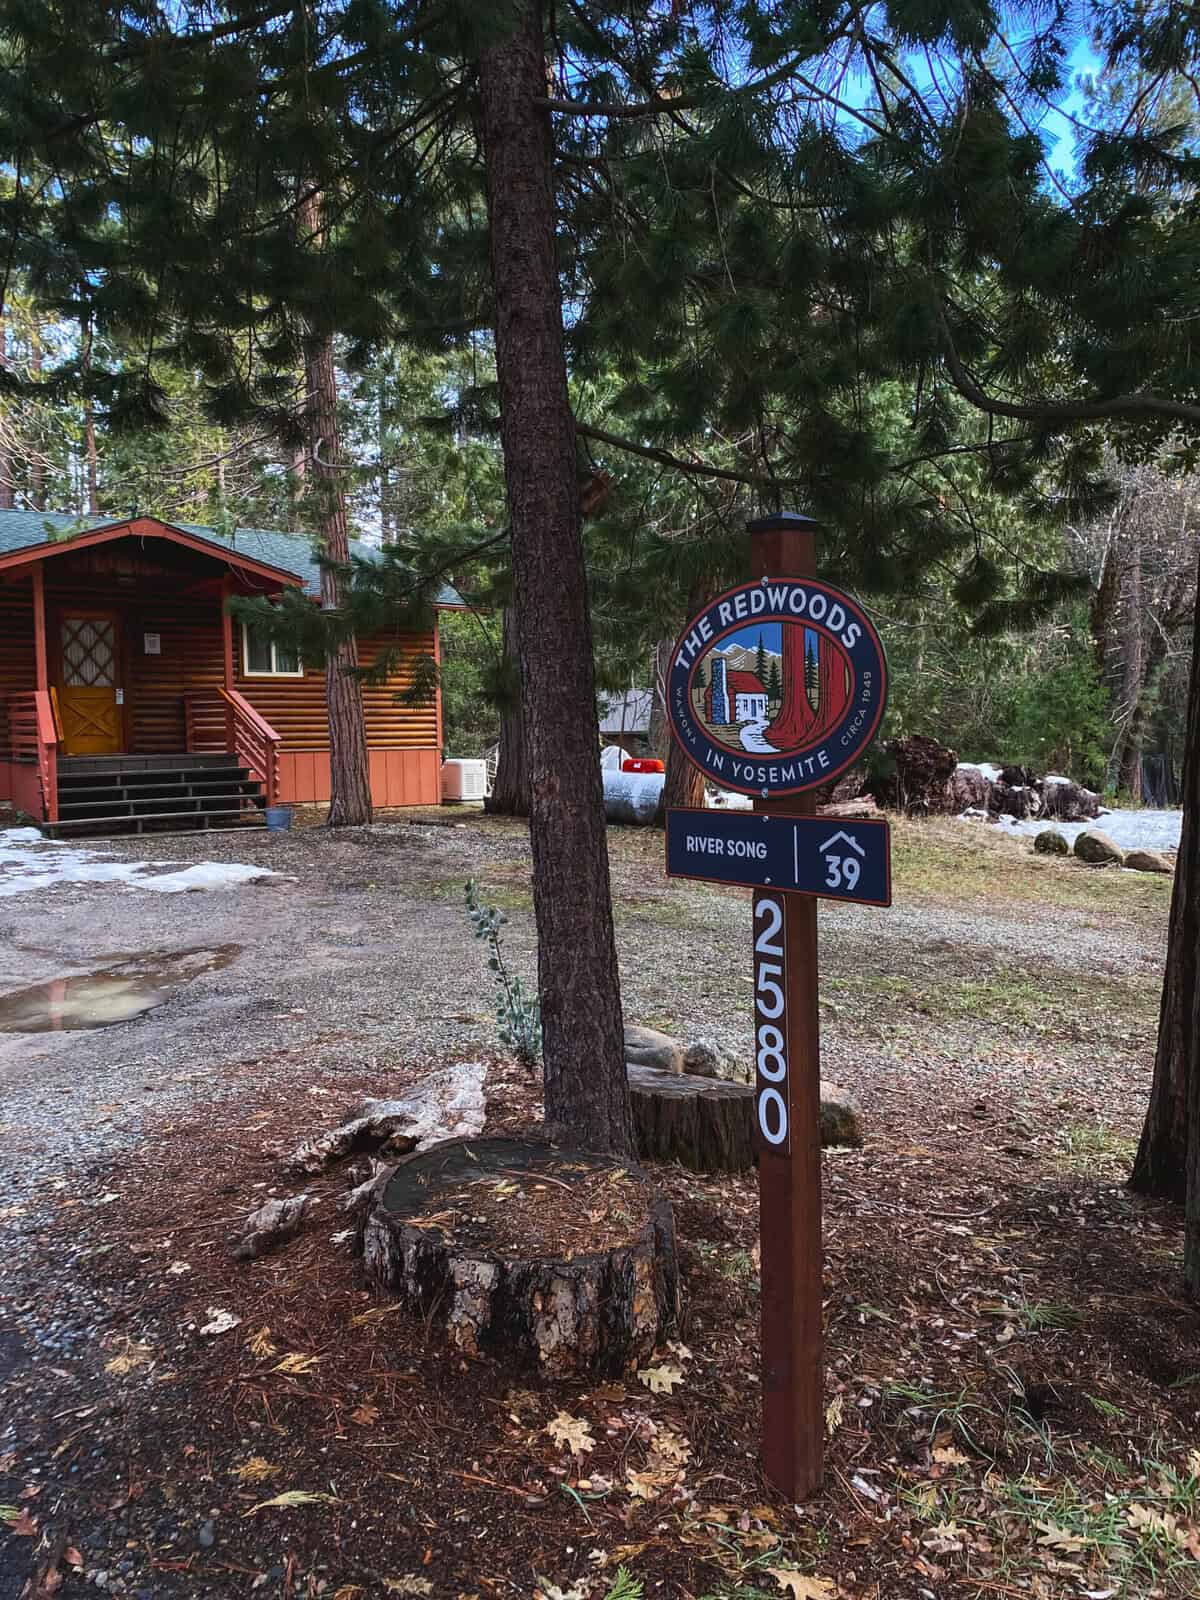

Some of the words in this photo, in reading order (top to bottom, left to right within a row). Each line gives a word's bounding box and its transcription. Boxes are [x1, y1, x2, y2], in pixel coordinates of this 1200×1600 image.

[675, 617, 714, 669] THE
[718, 586, 862, 649] REDWOODS
[841, 709, 867, 746] CIRCA
[862, 671, 872, 703] 1949
[705, 749, 724, 771] IN
[732, 750, 831, 783] YOSEMITE
[686, 835, 724, 855] RIVER
[727, 840, 768, 859] SONG
[825, 855, 861, 890] 39
[754, 898, 788, 1145] 2580
